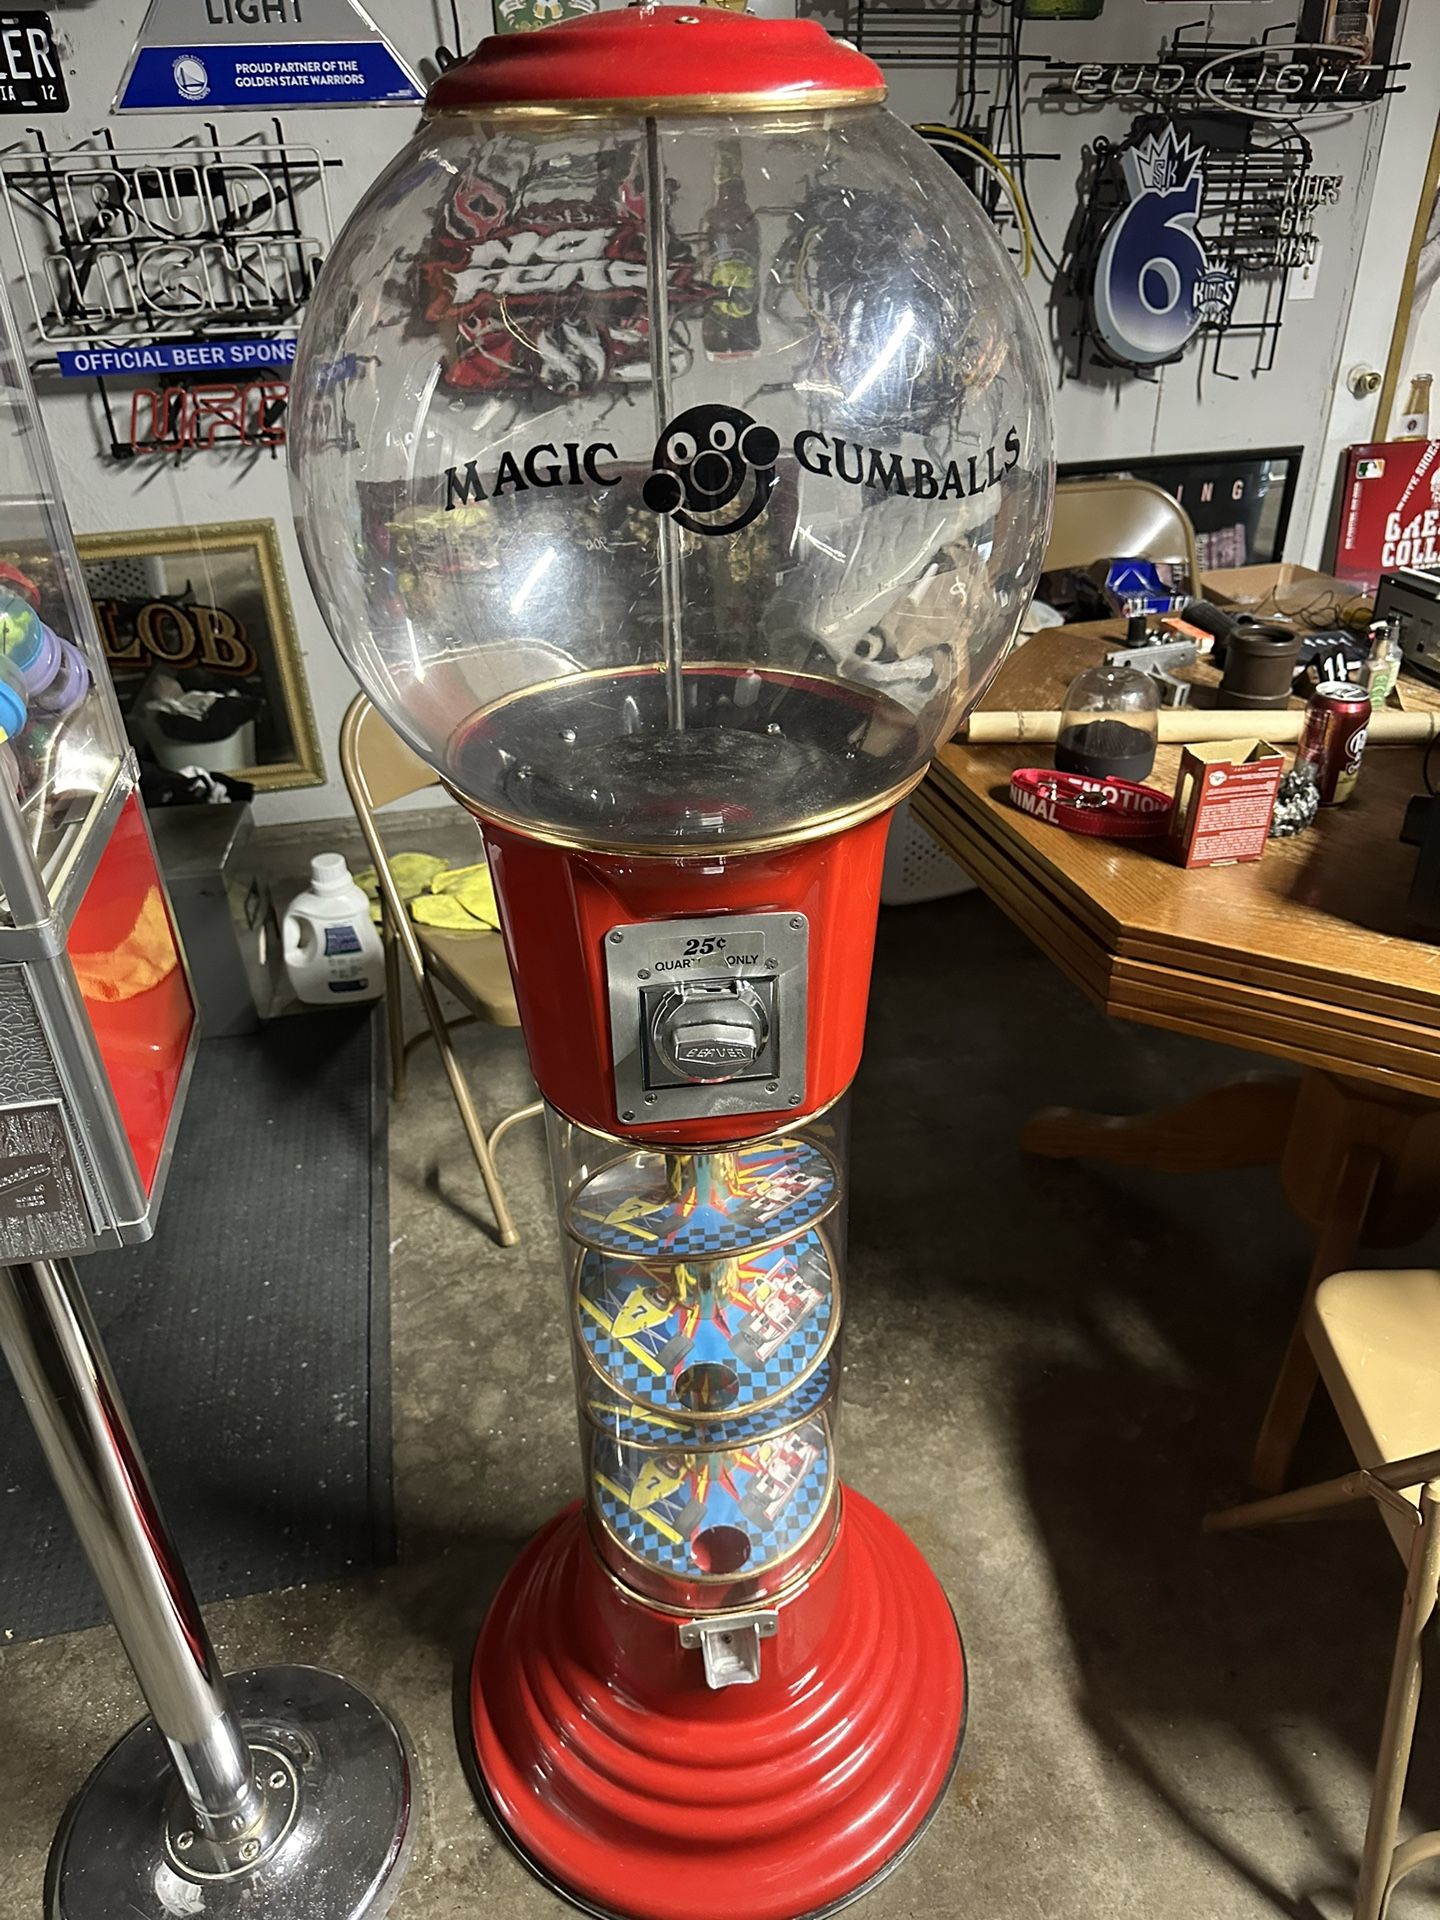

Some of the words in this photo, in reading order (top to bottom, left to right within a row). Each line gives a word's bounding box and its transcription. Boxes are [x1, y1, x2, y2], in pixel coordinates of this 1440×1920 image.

[0, 28, 57, 79] ER
[235, 63, 273, 74] PROUD
[274, 61, 321, 73] PARTNER
[322, 61, 337, 72] OF
[338, 60, 359, 71] THE
[41, 84, 57, 100] 12
[235, 76, 279, 88] GOLDEN
[280, 75, 310, 86] STATE
[310, 74, 365, 86] WARRIORS
[64, 162, 277, 242] BUD
[1094, 172, 1208, 364] 6
[43, 237, 323, 326] LIGHT
[1193, 281, 1235, 307] KINGS
[74, 350, 168, 372] OFFICIAL
[172, 346, 226, 366] BEER
[131, 382, 289, 453] UFC
[444, 442, 622, 511] MAGIC
[793, 425, 1021, 500] GUMBALLS
[1384, 509, 1440, 543] GRE
[1381, 536, 1440, 568] COLL
[683, 936, 727, 956] 25¢
[726, 954, 759, 965] ONLY
[686, 1048, 746, 1058] BEAVER
[631, 1304, 648, 1320] 7
[646, 1475, 662, 1491] 7
